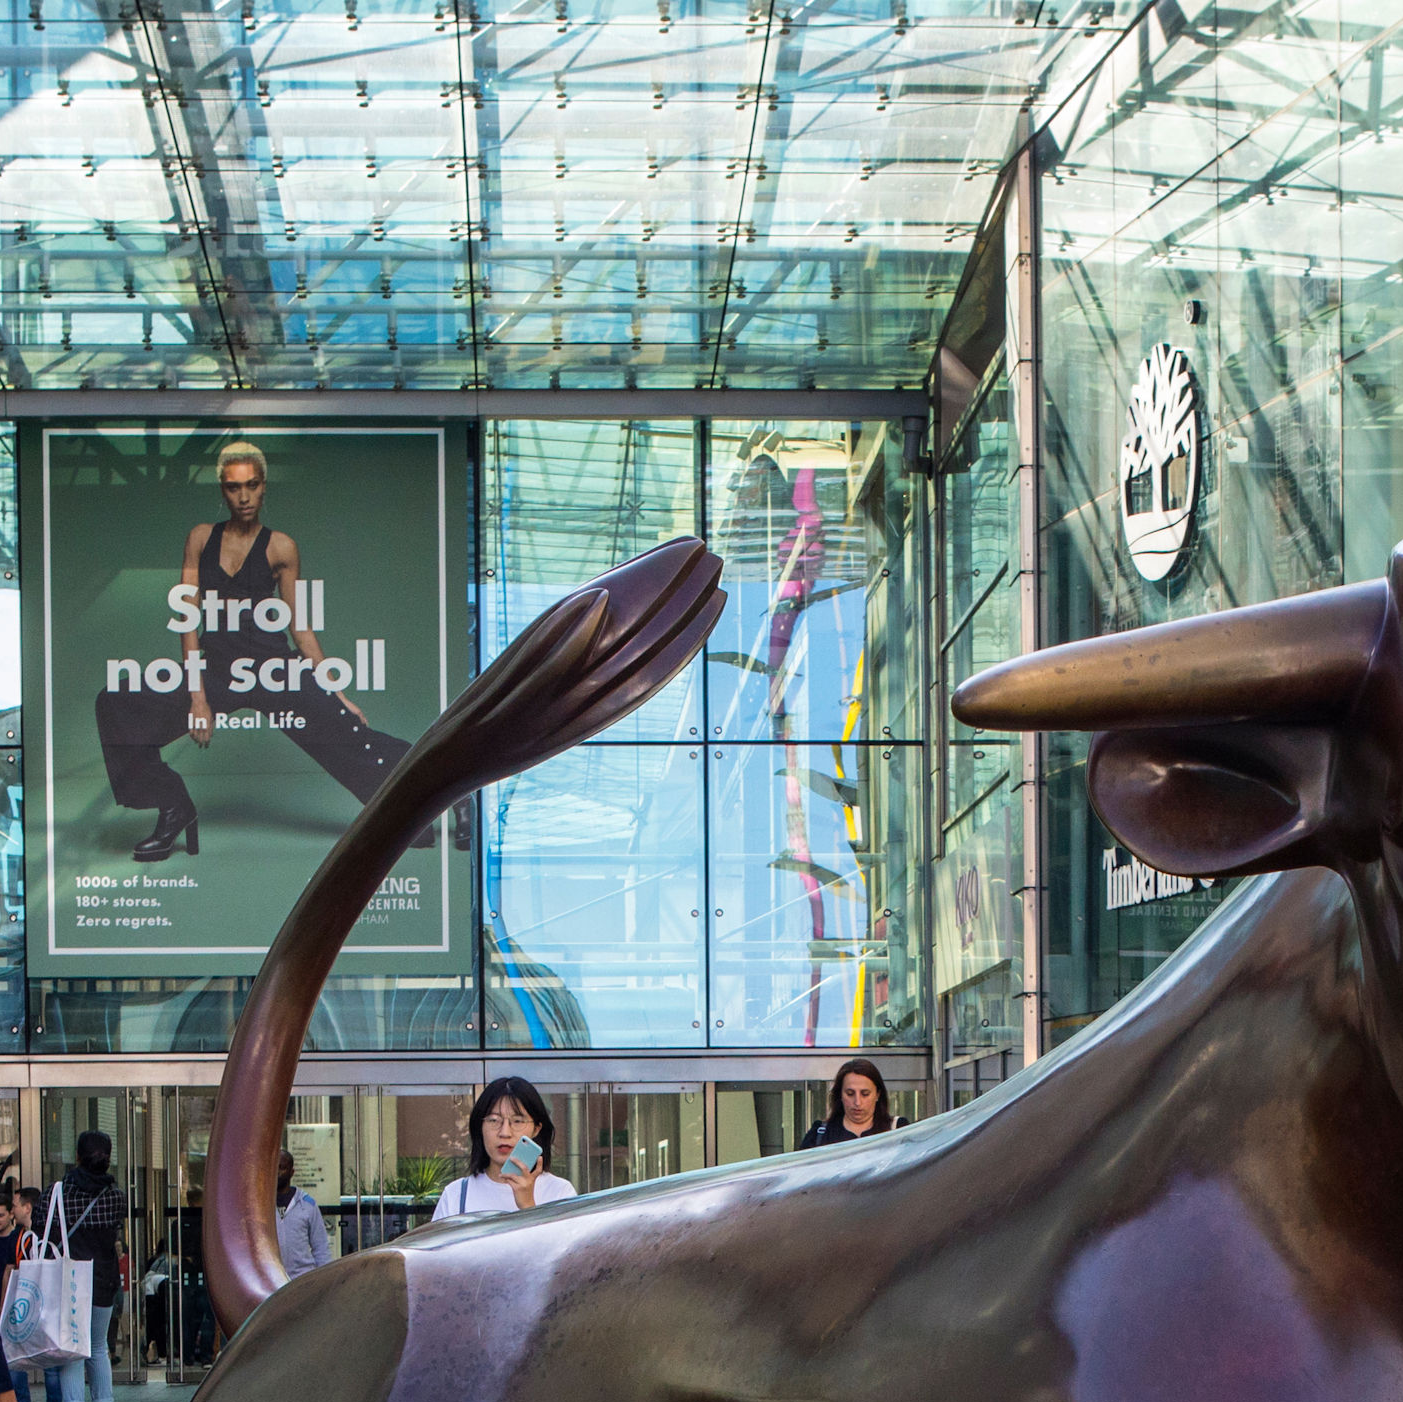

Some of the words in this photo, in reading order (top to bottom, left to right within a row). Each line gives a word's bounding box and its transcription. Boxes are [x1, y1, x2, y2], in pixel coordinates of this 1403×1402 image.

[166, 579, 325, 633] Stroll
[106, 649, 207, 694] not
[228, 639, 386, 693] scroll
[188, 713, 207, 730] In
[215, 711, 261, 730] Real
[269, 711, 306, 729] Life
[76, 875, 118, 888] 1000s
[123, 875, 138, 888] of
[143, 875, 198, 888] brands.
[76, 896, 109, 907] 180+
[112, 897, 161, 908] stores.
[367, 898, 421, 911] CENTRAL
[955, 865, 979, 929] KIKO
[76, 915, 110, 926] Zero
[115, 915, 172, 929] regrets.
